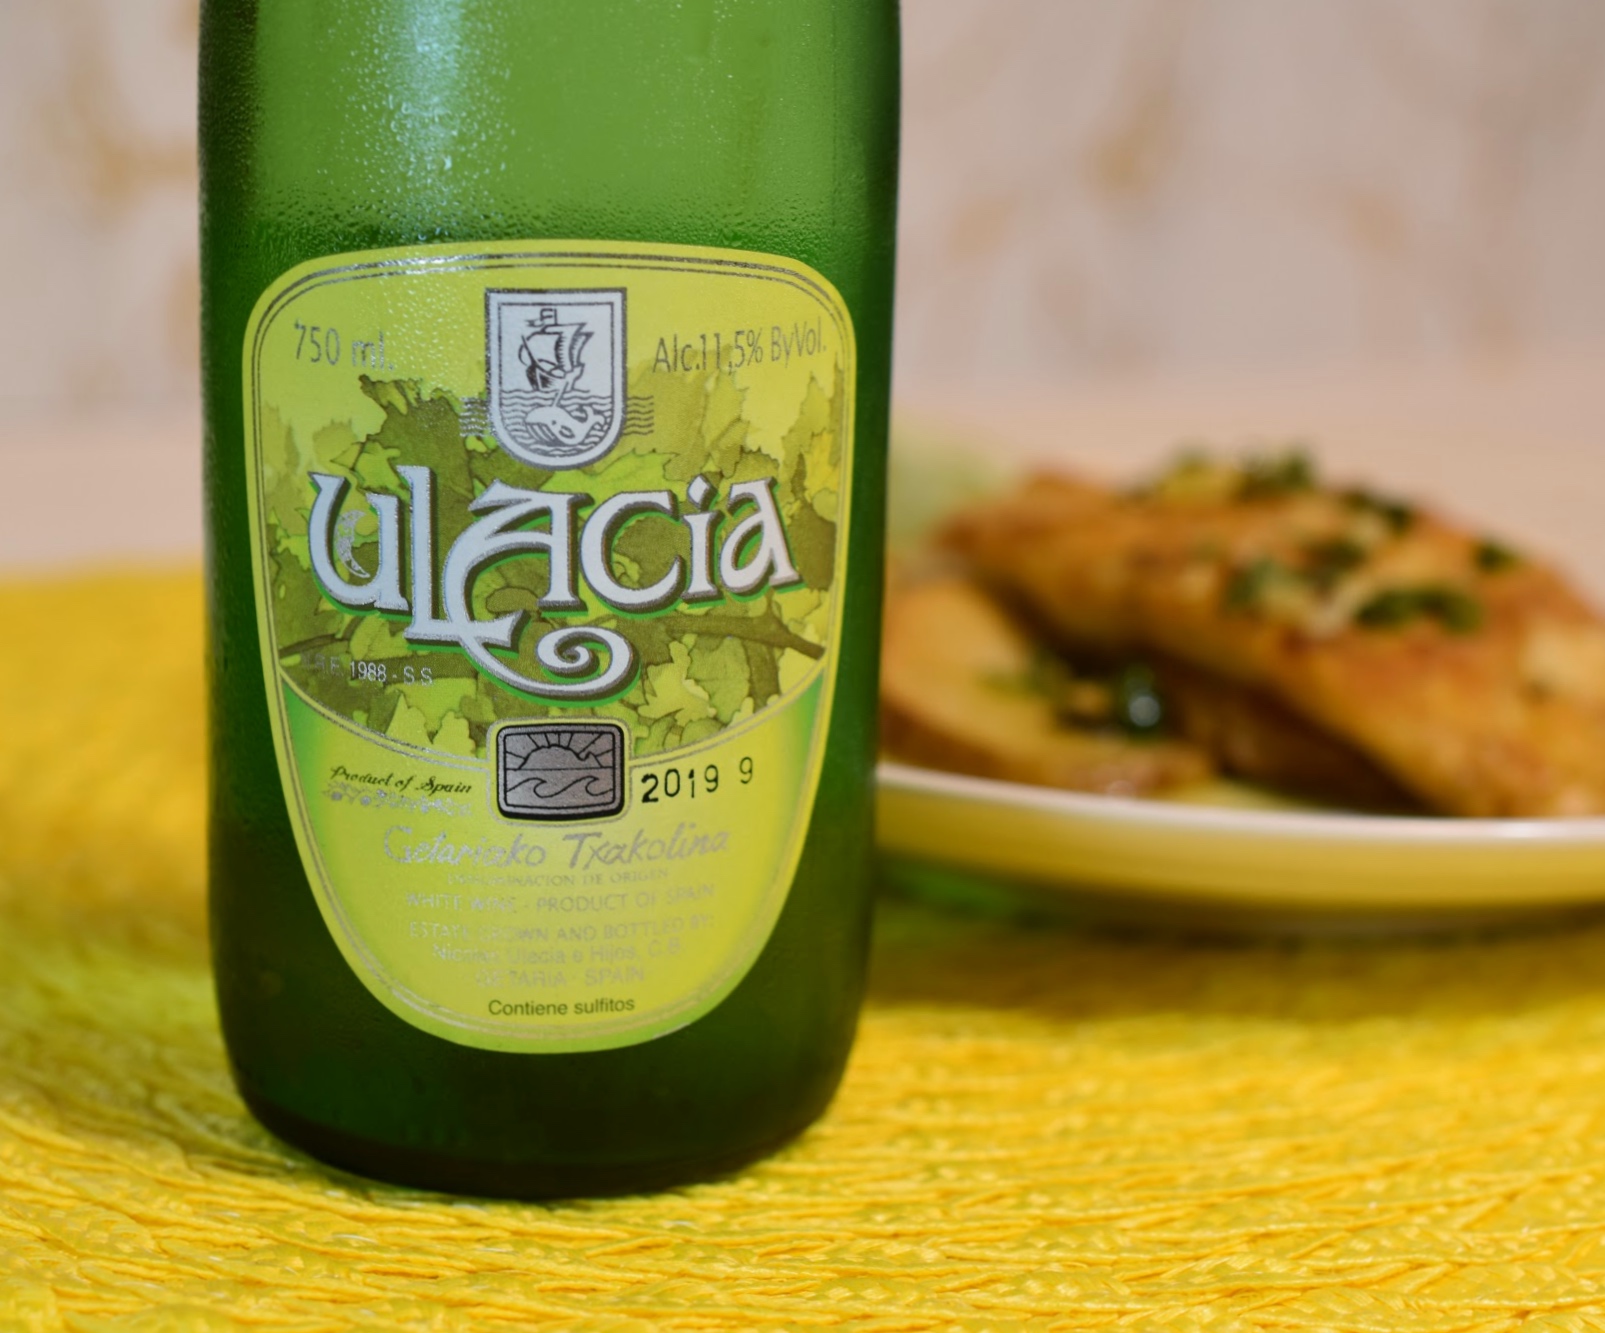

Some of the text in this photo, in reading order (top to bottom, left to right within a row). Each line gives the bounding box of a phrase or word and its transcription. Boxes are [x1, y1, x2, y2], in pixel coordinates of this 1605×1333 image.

[295, 318, 341, 366] 750
[350, 660, 387, 683] 1988
[330, 765, 472, 797] Product of Spain
[641, 756, 753, 803] 2019 9
[384, 822, 730, 870] Getariako Txakolina
[582, 873, 604, 886] DE
[610, 867, 668, 884] ORIGEN
[405, 892, 463, 912] WHITE
[470, 894, 518, 914] WINE
[537, 893, 628, 914] PRODUCT
[635, 891, 656, 909] OF
[666, 883, 715, 905] SPAIN
[557, 925, 597, 942] AND
[604, 916, 684, 940] BOTTLED
[584, 966, 644, 988] SPAIN
[488, 997, 636, 1017] Contiene sulfitos
